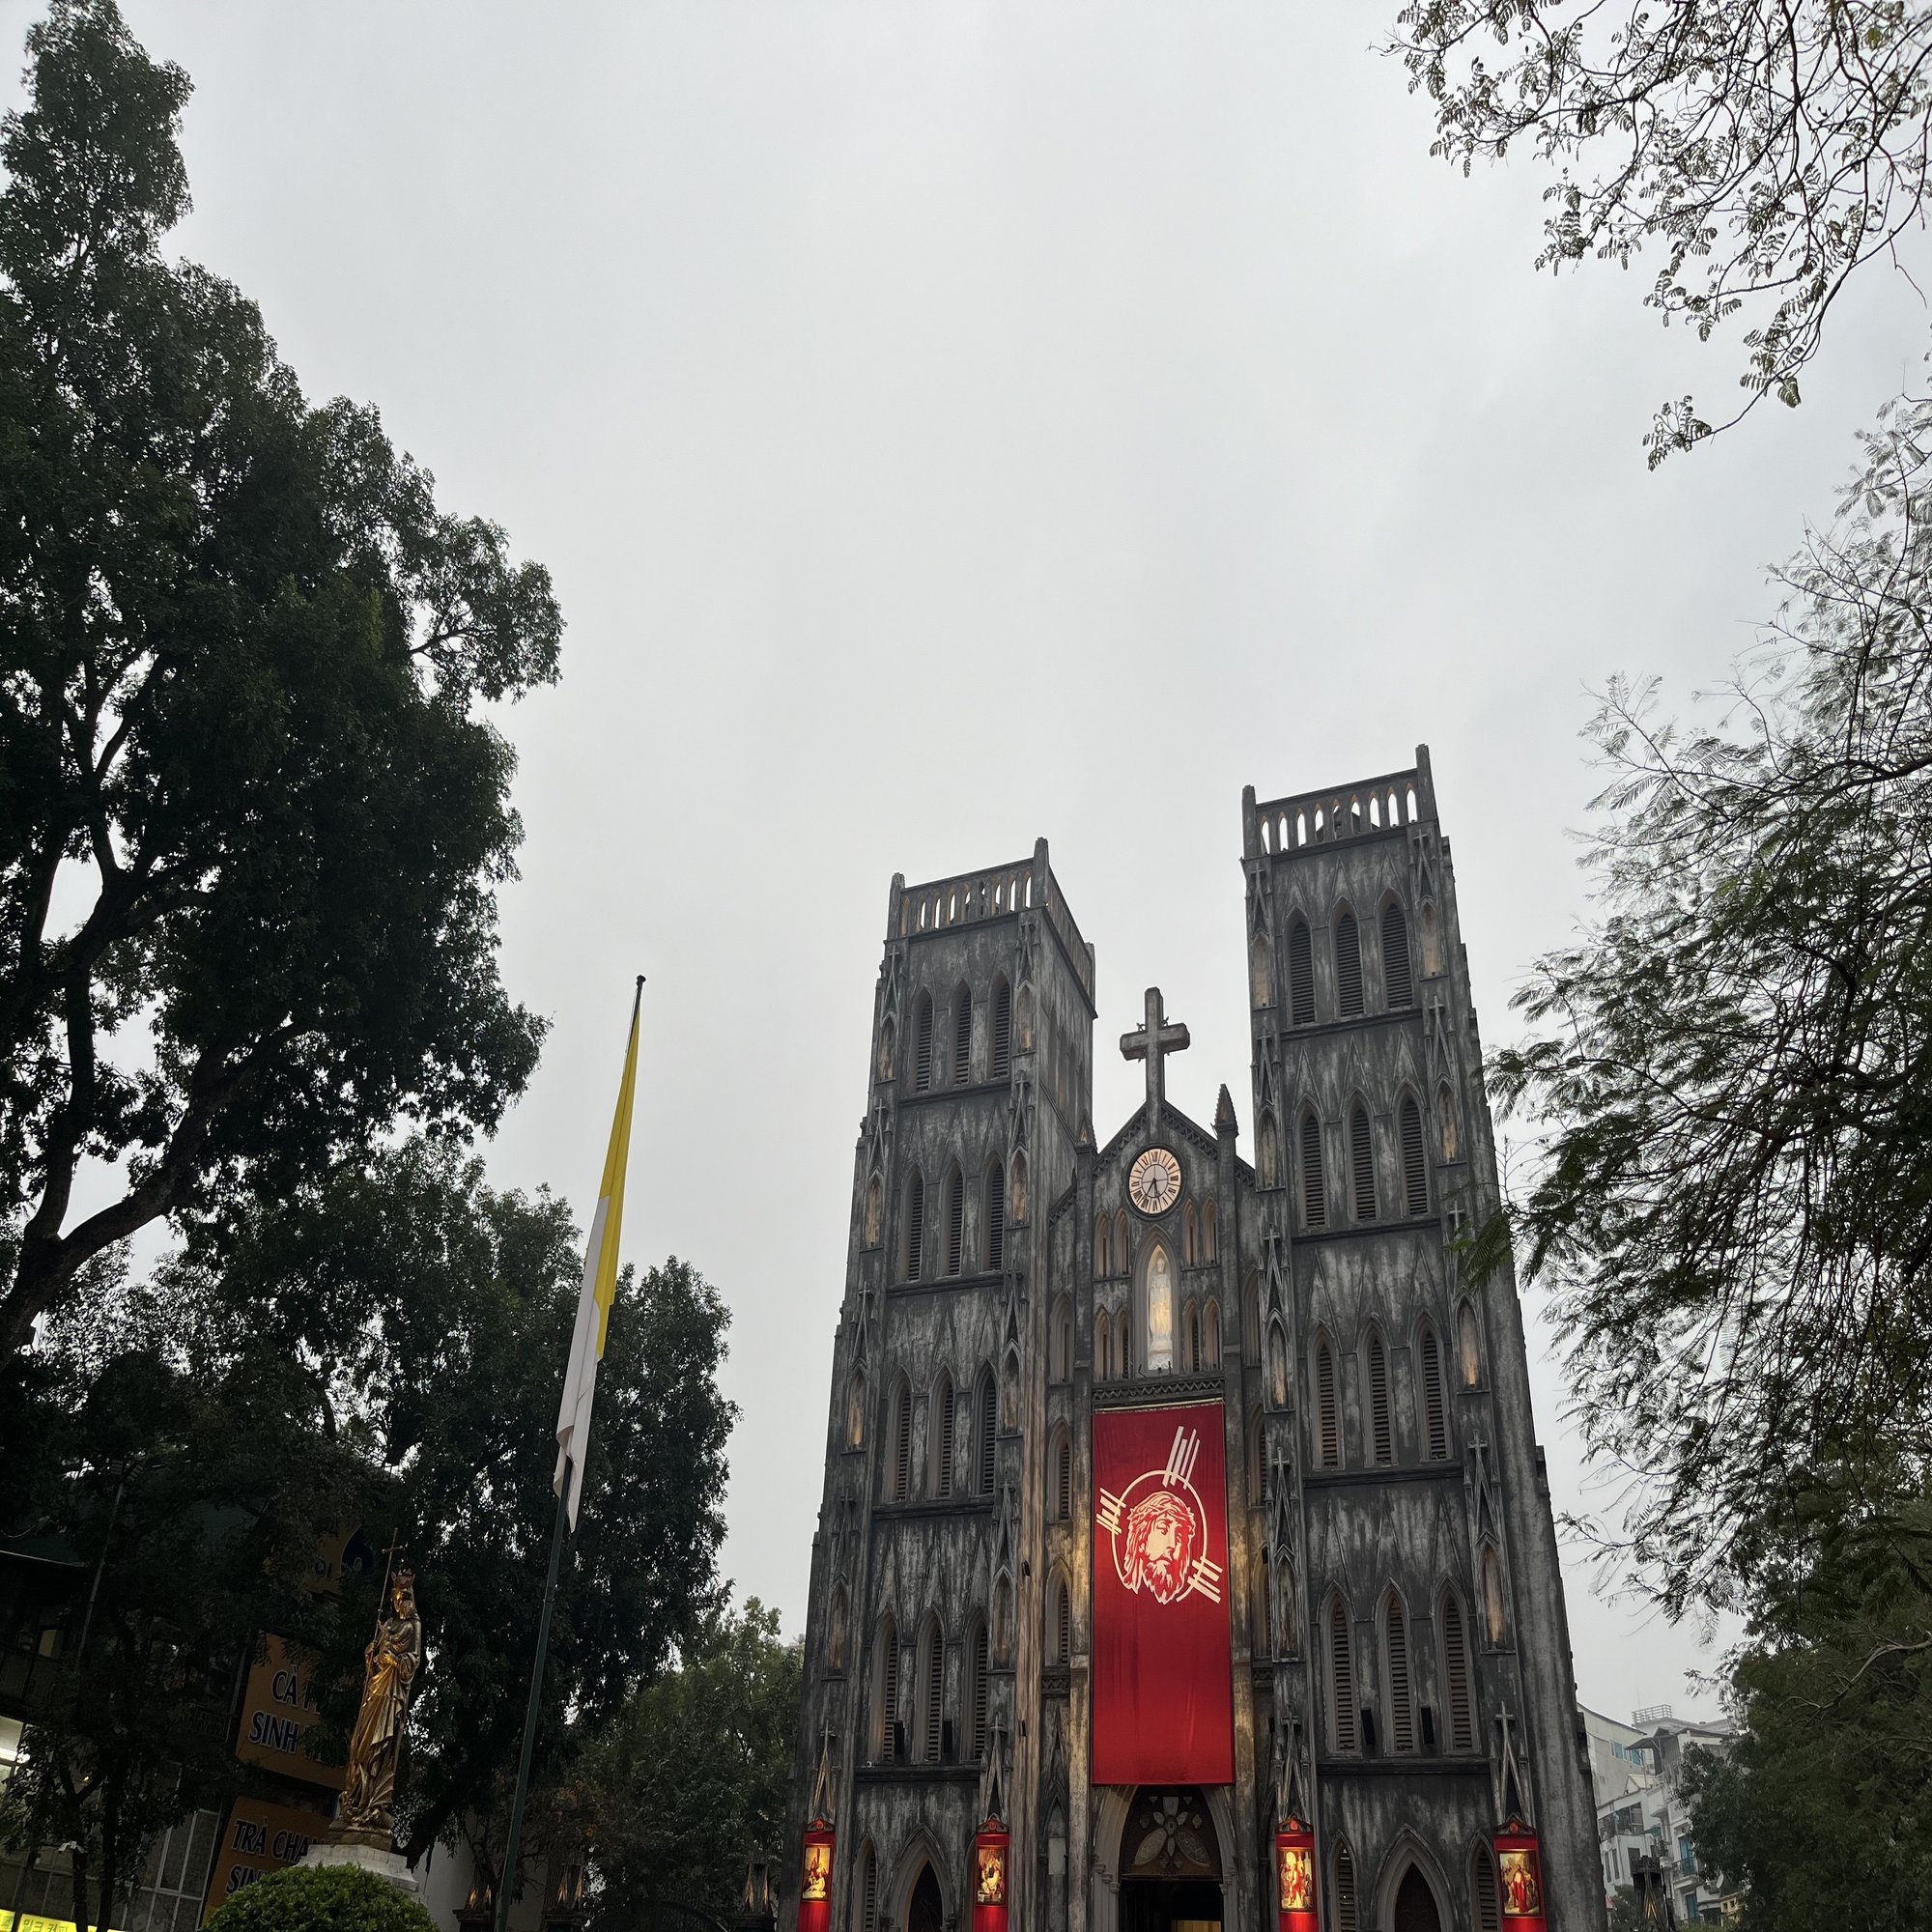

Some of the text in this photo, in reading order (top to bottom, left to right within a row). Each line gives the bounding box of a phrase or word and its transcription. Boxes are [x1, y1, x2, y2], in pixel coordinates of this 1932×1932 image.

[271, 1663, 298, 1708] CÀ
[248, 1710, 299, 1756] SINH
[232, 1816, 325, 1861] TRÀ CHA
